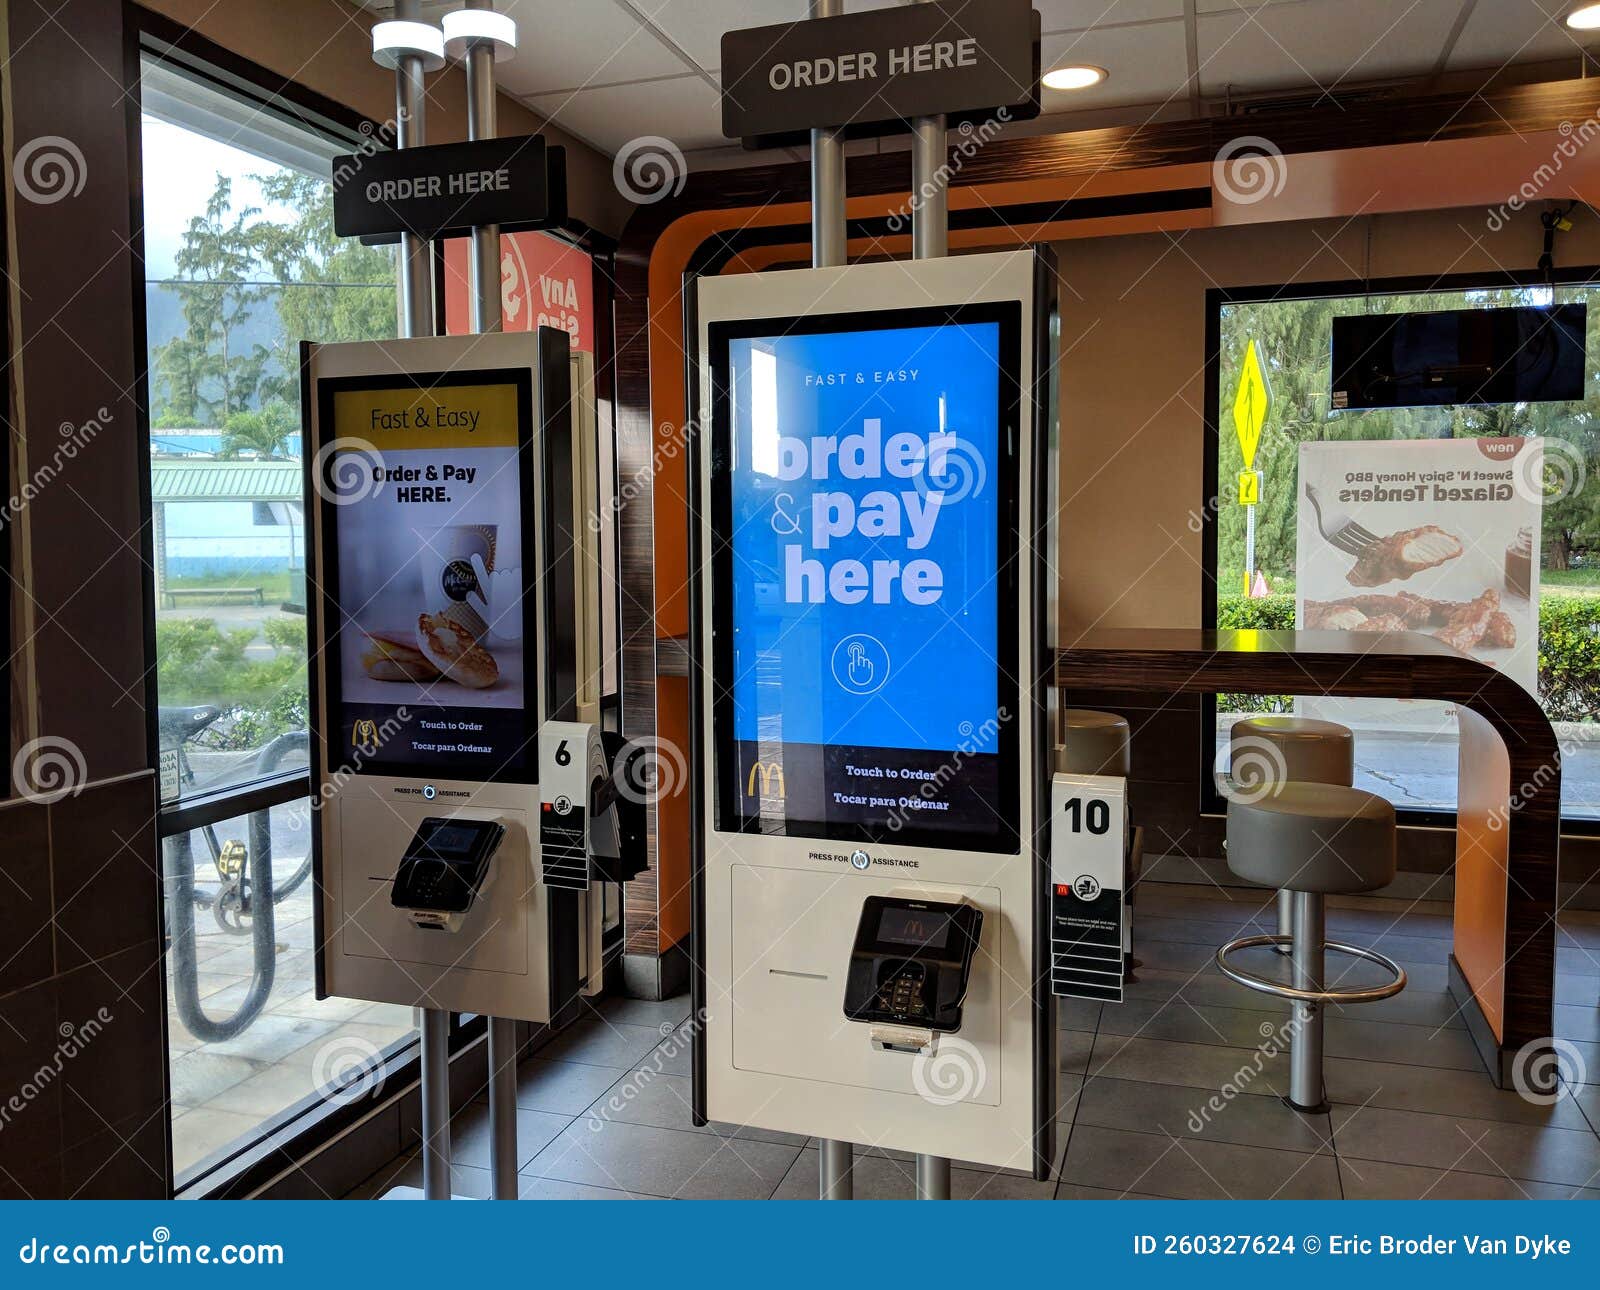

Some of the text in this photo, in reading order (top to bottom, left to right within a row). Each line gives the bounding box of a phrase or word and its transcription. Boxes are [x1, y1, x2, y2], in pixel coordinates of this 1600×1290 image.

[769, 38, 977, 90] ORDER HERE
[366, 169, 511, 203] ORDER HERE
[805, 369, 919, 387] FAST & EASY
[371, 406, 480, 432] Fast & Easy
[775, 418, 957, 481] order
[372, 464, 476, 484] Order & Pay
[397, 487, 452, 503] HERE.
[770, 490, 945, 550] & pay
[785, 544, 943, 605] here
[420, 720, 484, 731] Touch to Order
[412, 742, 493, 754] Tocar para Ordenar
[555, 740, 571, 766] 6
[846, 765, 937, 781] Touch to Order
[833, 792, 950, 811] Tocar para Ordenar
[1064, 797, 1110, 835] 10
[809, 852, 920, 868] PRESS FOR ASSISTANCE
